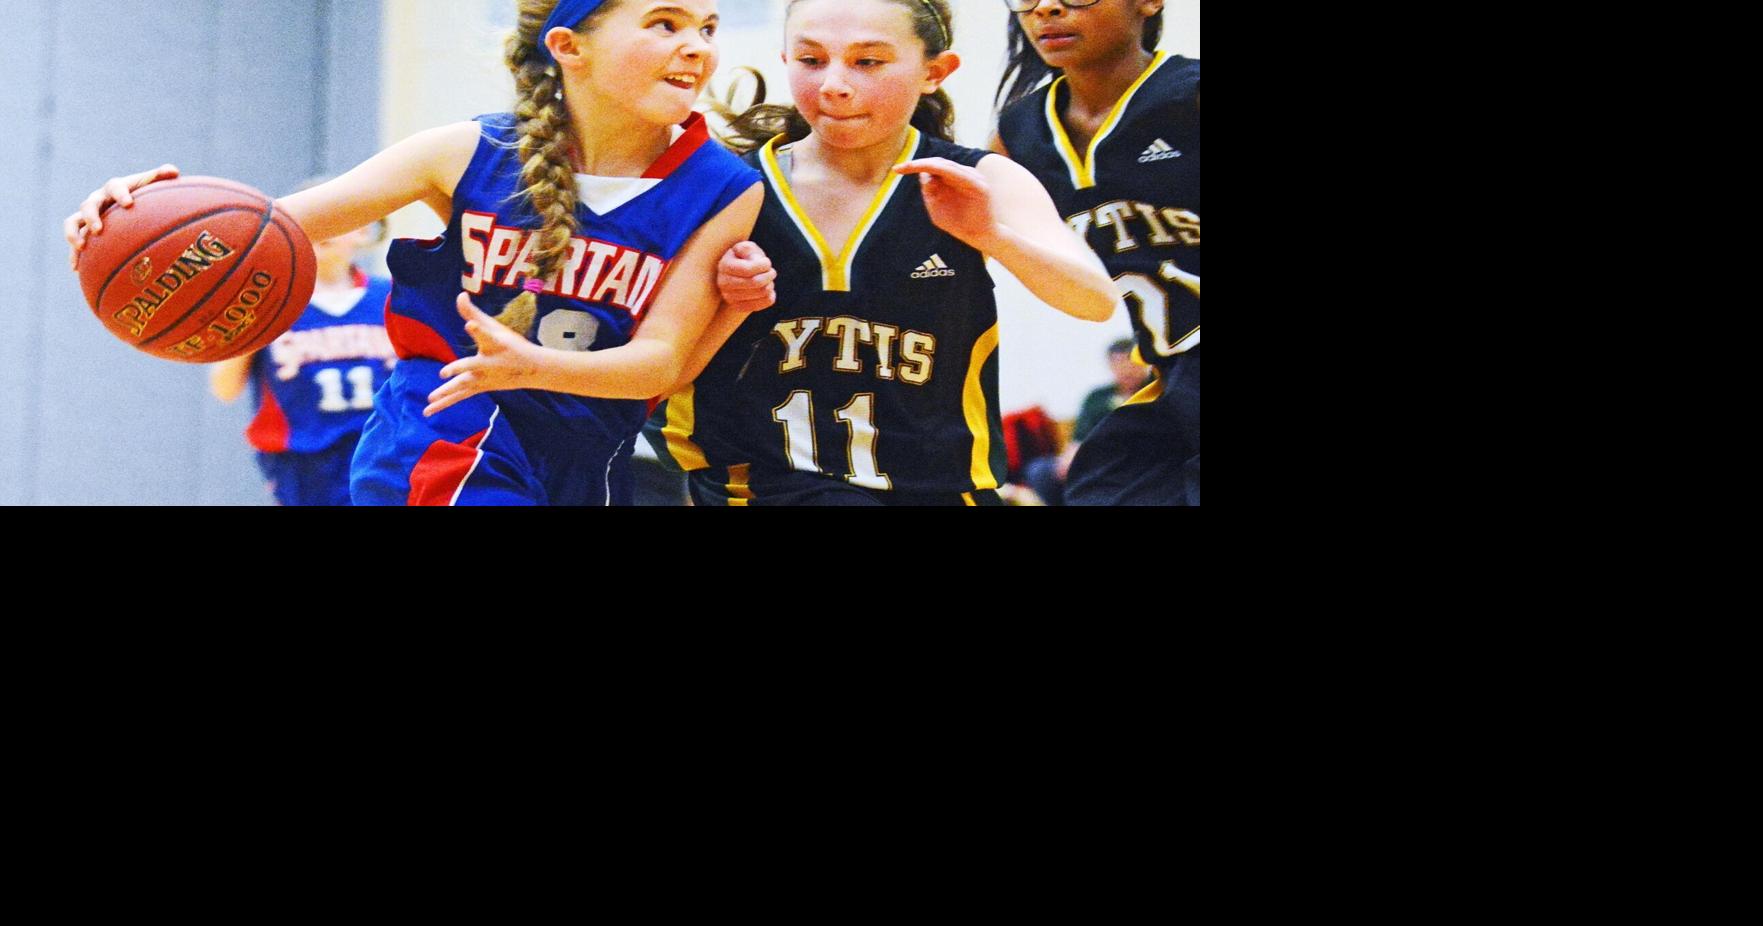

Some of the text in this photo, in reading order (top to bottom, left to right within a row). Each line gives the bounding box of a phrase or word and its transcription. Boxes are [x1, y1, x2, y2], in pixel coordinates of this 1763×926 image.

[1137, 149, 1183, 163] adidas
[113, 229, 236, 337] SPALDING
[910, 268, 956, 279] adidas
[769, 314, 937, 386] YTIS
[314, 365, 374, 412] 11
[771, 388, 894, 491] 11
